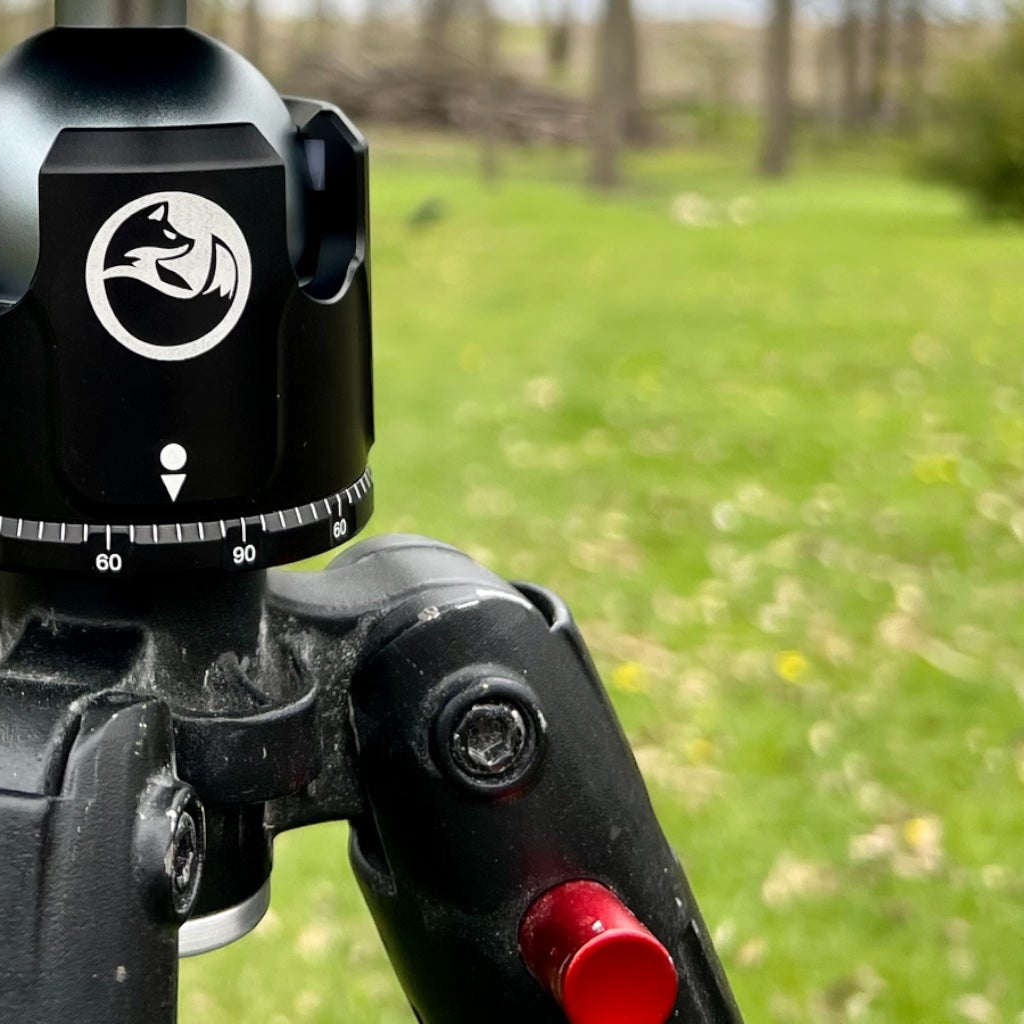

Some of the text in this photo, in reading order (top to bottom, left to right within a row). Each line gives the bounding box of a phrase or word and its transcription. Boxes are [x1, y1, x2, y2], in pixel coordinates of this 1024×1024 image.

[333, 518, 347, 538] 60
[95, 553, 122, 571] 60
[232, 544, 256, 564] 90
